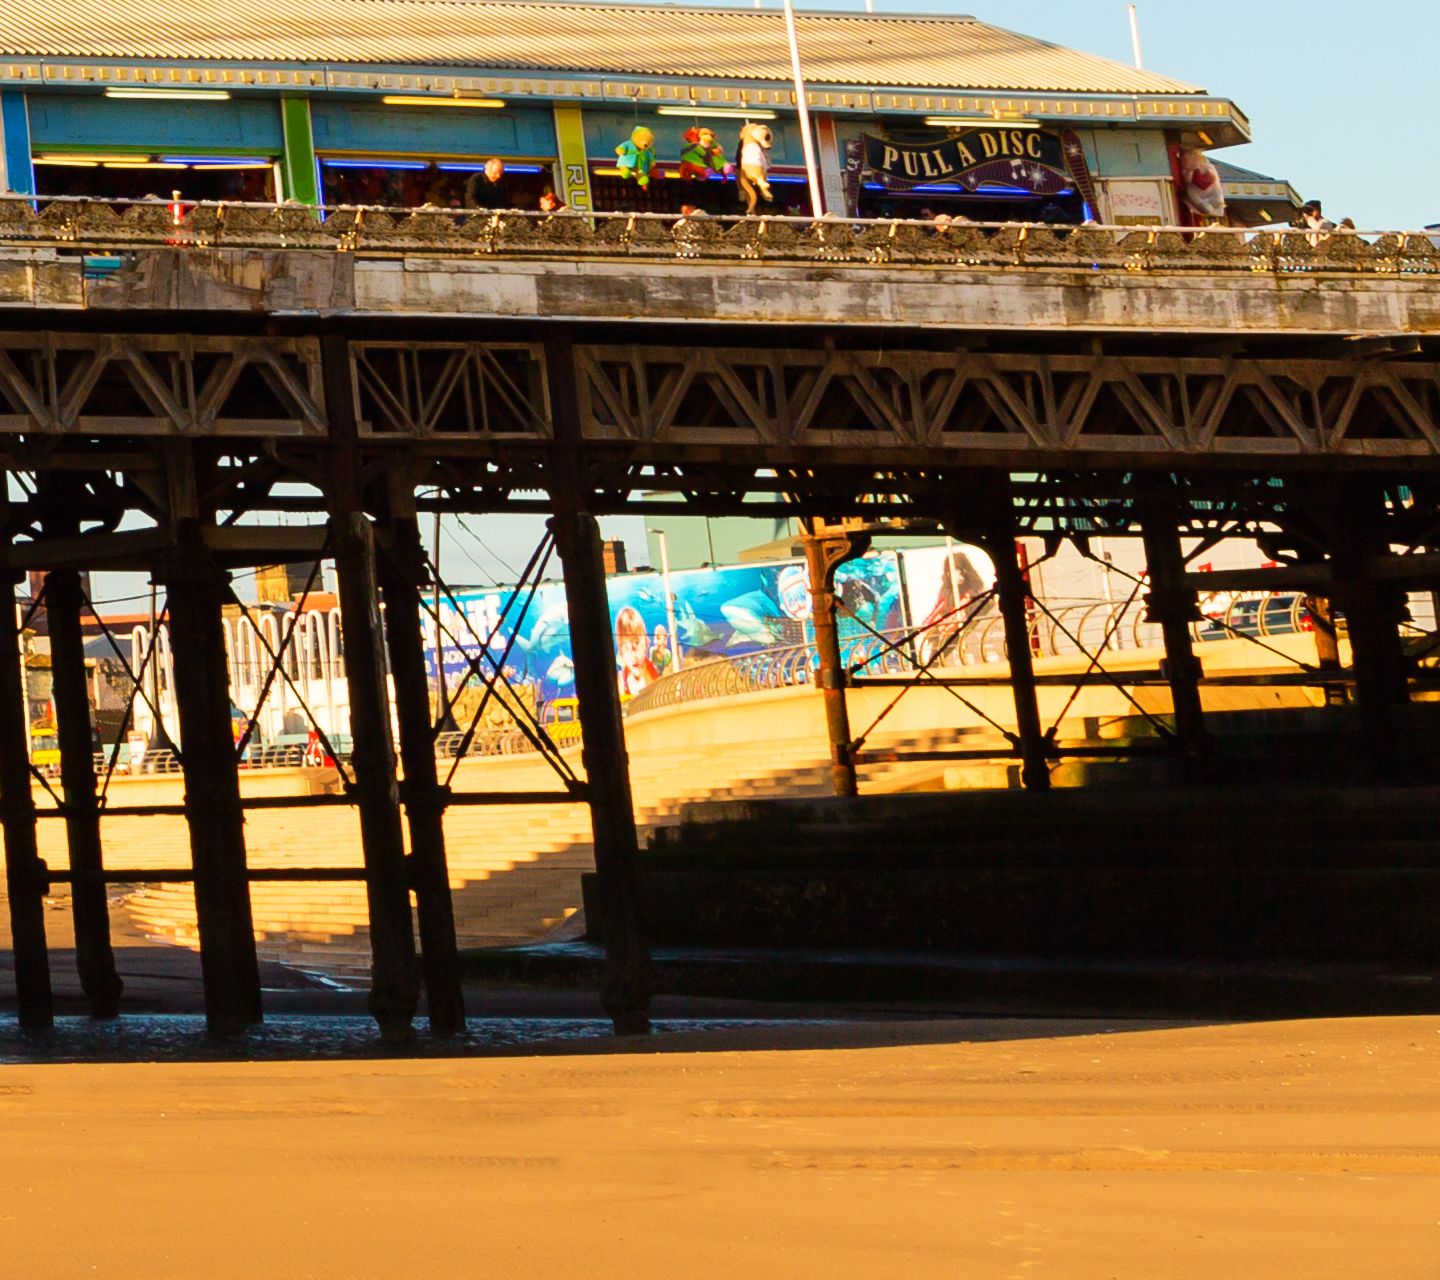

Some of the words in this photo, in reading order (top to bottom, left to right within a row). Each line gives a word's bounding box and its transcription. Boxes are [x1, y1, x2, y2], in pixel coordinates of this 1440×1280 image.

[882, 144, 954, 178] PULL
[957, 141, 977, 168] A
[979, 130, 1042, 159] DISC
